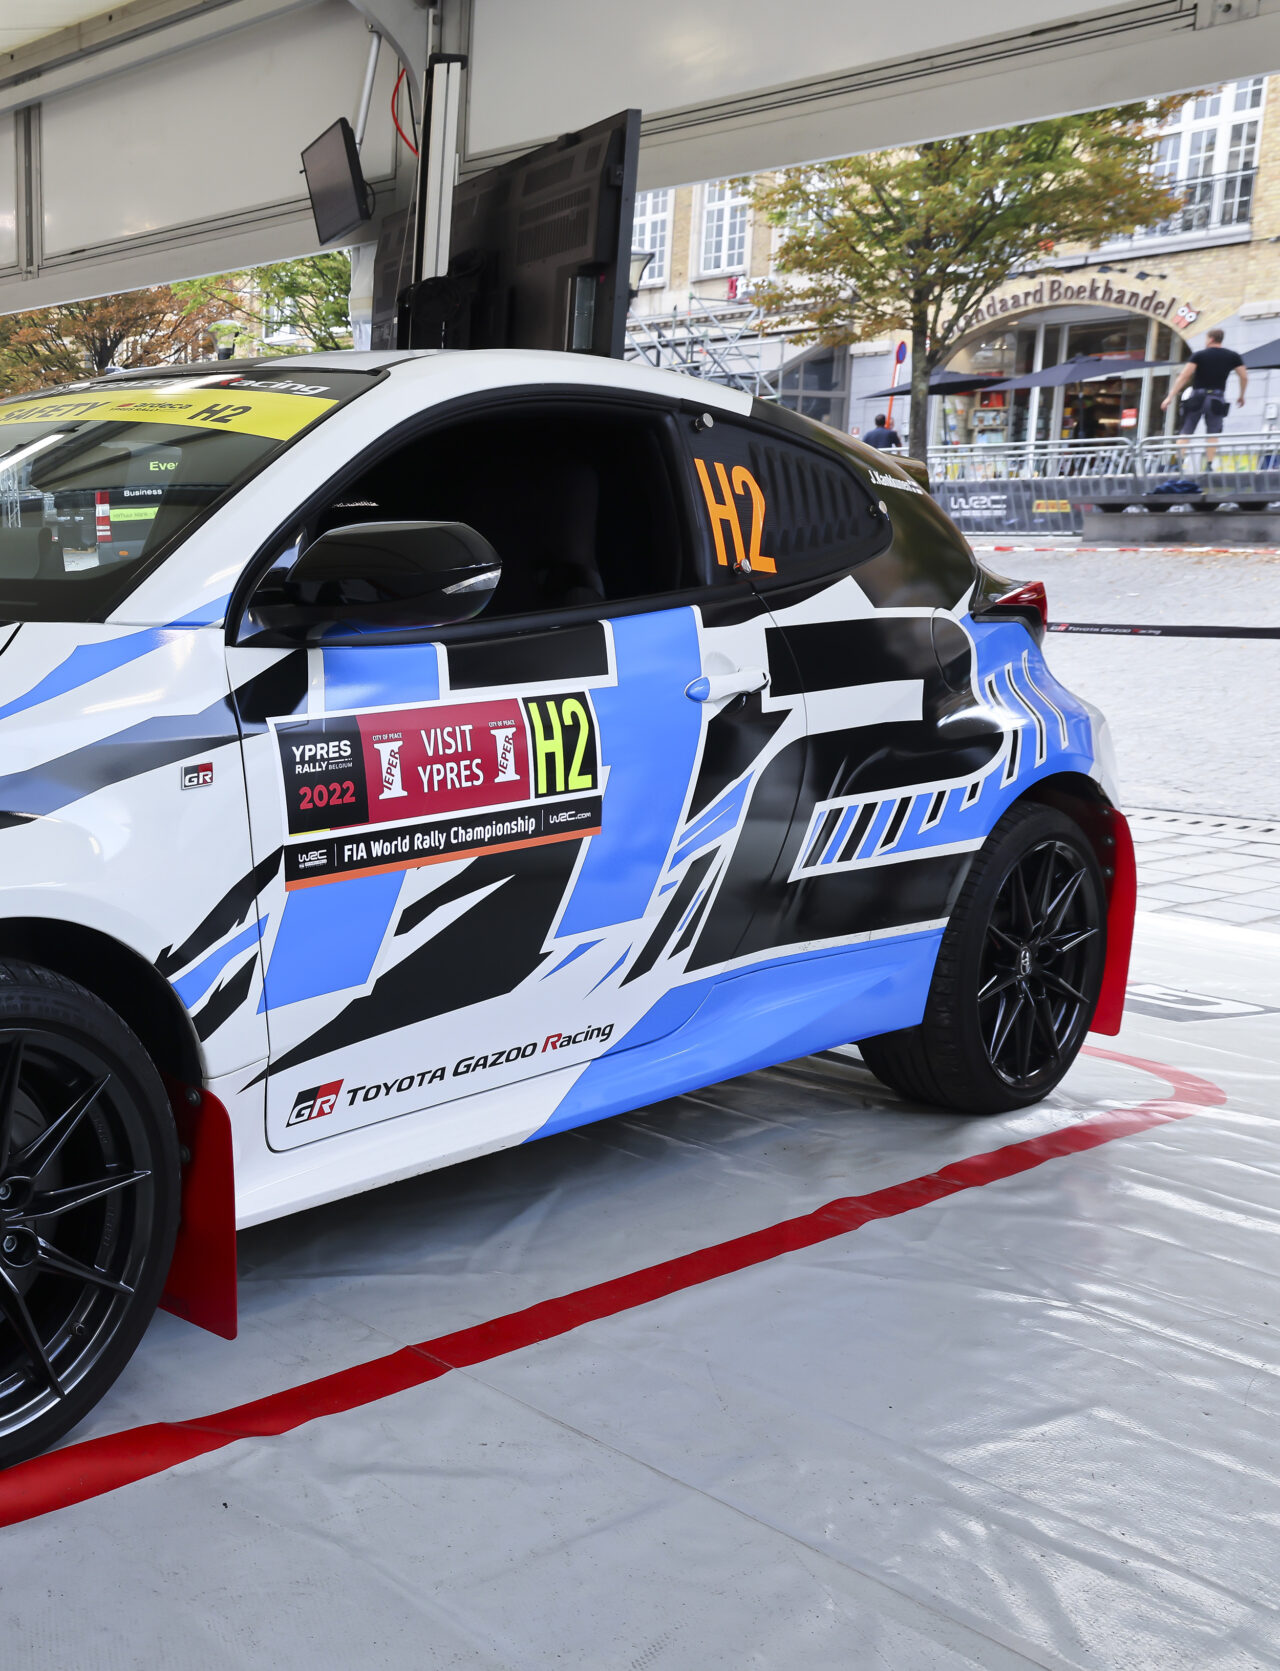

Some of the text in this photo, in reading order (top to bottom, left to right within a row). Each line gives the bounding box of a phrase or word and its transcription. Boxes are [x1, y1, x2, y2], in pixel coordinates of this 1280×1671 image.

[1049, 278, 1176, 319] Boekhandel
[187, 403, 253, 424] H2
[123, 488, 163, 497] Business
[694, 457, 777, 573] H2
[372, 734, 382, 742] CITY
[389, 732, 402, 740] PEACE
[488, 720, 497, 728] CITY
[292, 739, 352, 762] YPRES
[420, 724, 473, 757] VISIT
[498, 735, 514, 775] IEPER
[528, 698, 593, 794] H2
[184, 770, 212, 786] GR
[295, 761, 353, 774] RALLY BELGIUM
[383, 749, 400, 791] IEPER
[417, 758, 484, 793] YPRES
[298, 780, 356, 810] 2022
[344, 815, 536, 863] FIA World Rally Championship
[298, 849, 328, 863] WRC
[287, 1023, 614, 1125] GR TOYOTA GAZOO Racing
